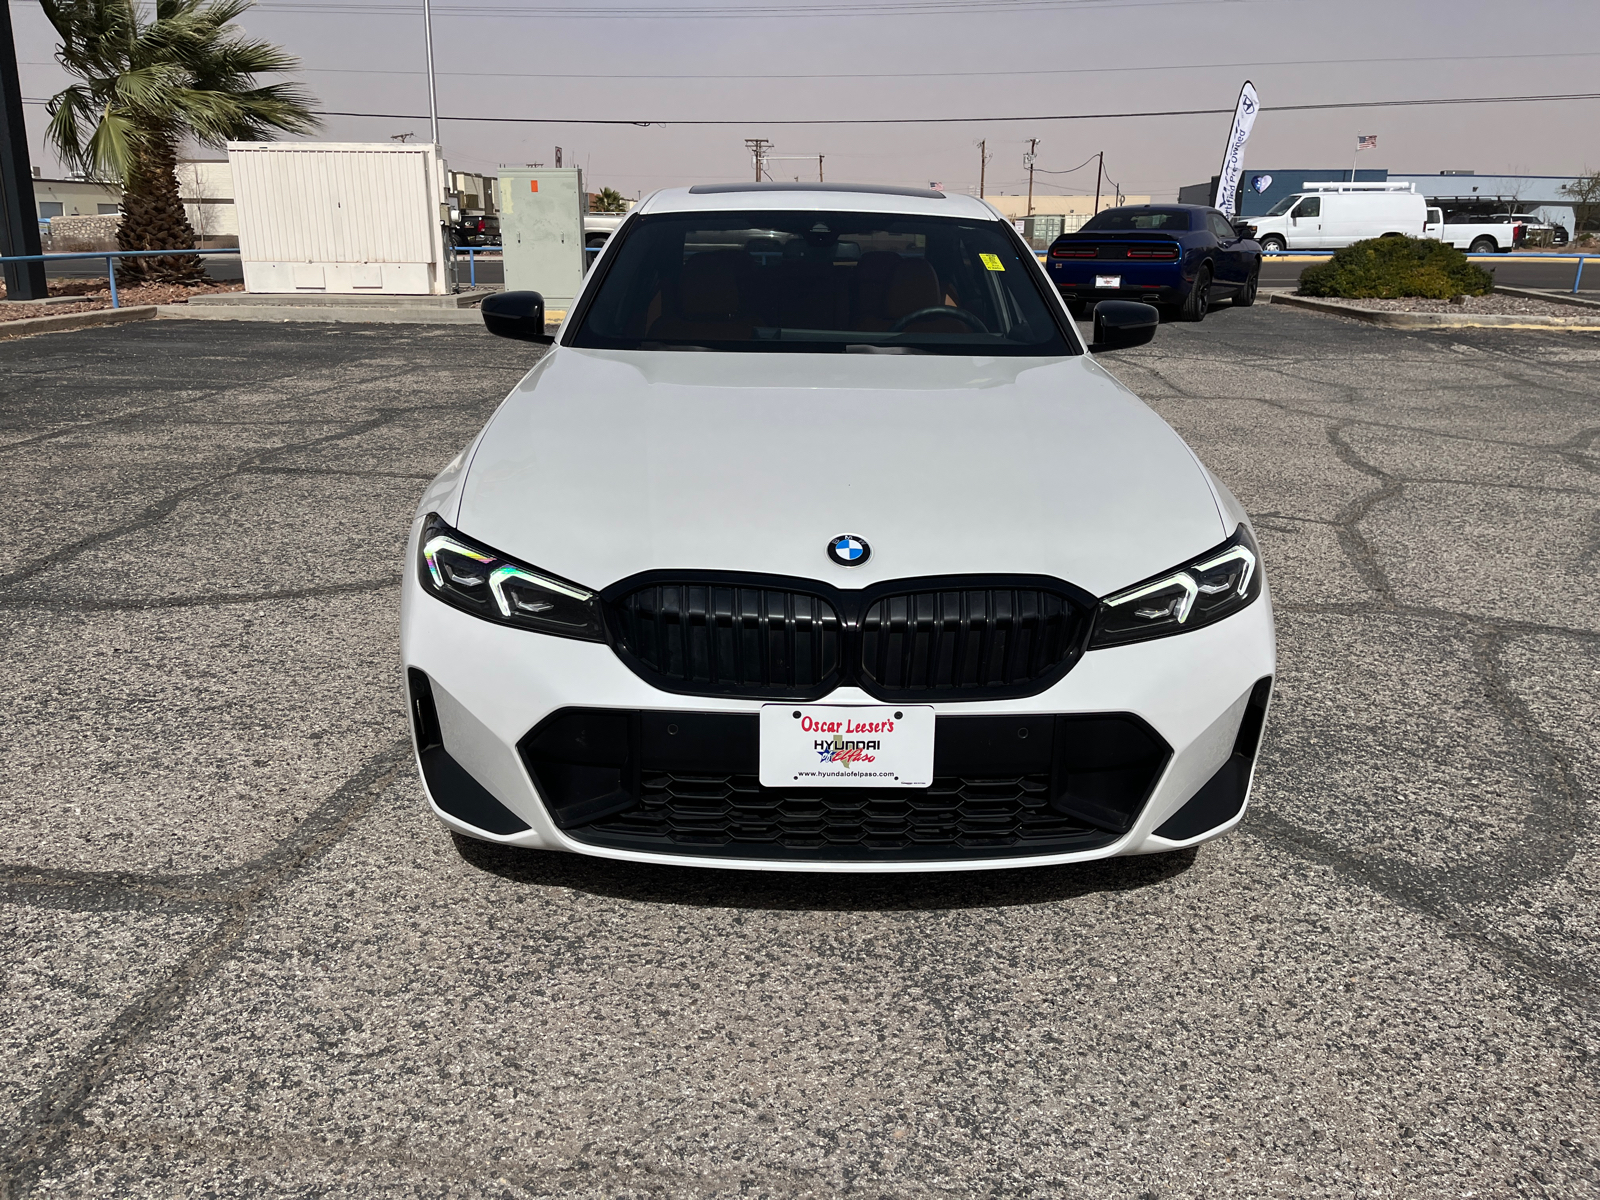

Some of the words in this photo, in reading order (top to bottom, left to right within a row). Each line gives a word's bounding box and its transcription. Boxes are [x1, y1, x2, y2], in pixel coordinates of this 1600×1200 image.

[1225, 184, 1236, 220] ertified
[832, 535, 867, 545] BMW
[801, 716, 842, 733] Oscar
[845, 718, 894, 733] Leeser's
[814, 740, 880, 750] HYUNDAI
[798, 770, 895, 778] www.hyundaiofelpaso.com
